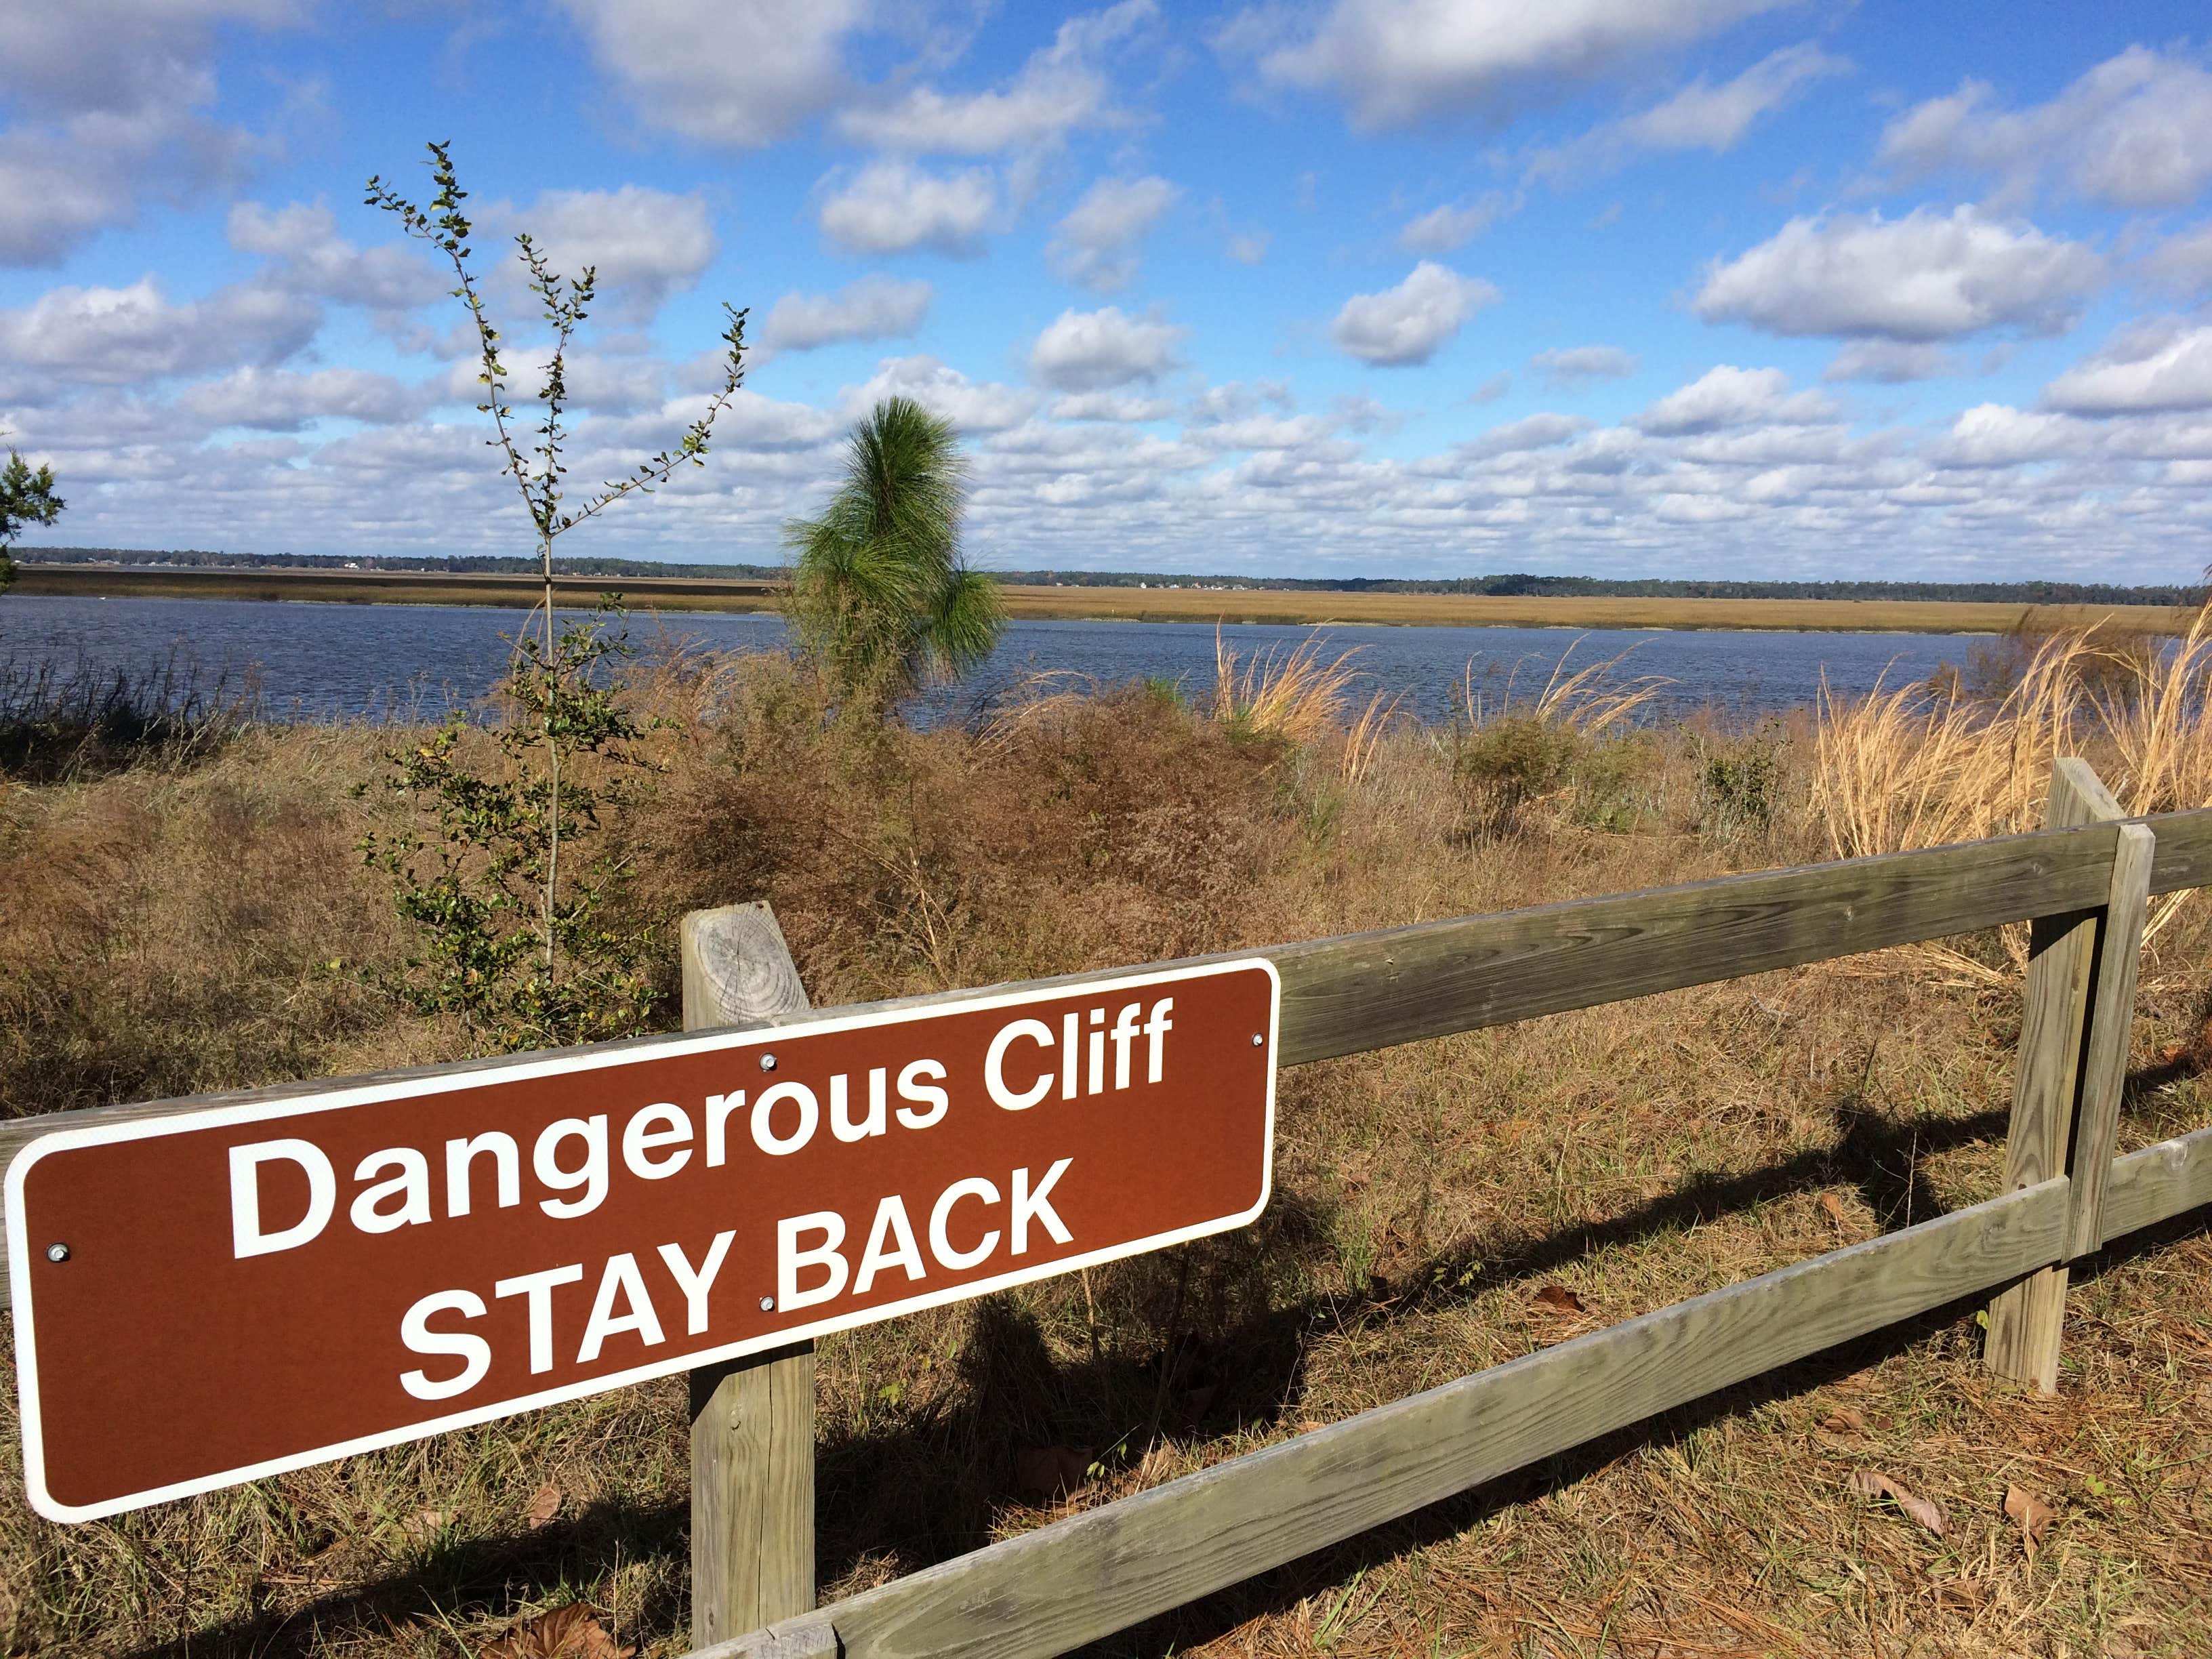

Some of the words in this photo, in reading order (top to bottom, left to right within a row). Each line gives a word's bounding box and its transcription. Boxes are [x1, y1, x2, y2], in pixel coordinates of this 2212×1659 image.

[229, 1059, 949, 1259] Dangerous
[985, 998, 1173, 1111] Cliff
[401, 1230, 737, 1400] STAY
[778, 1158, 1074, 1313] BACK
